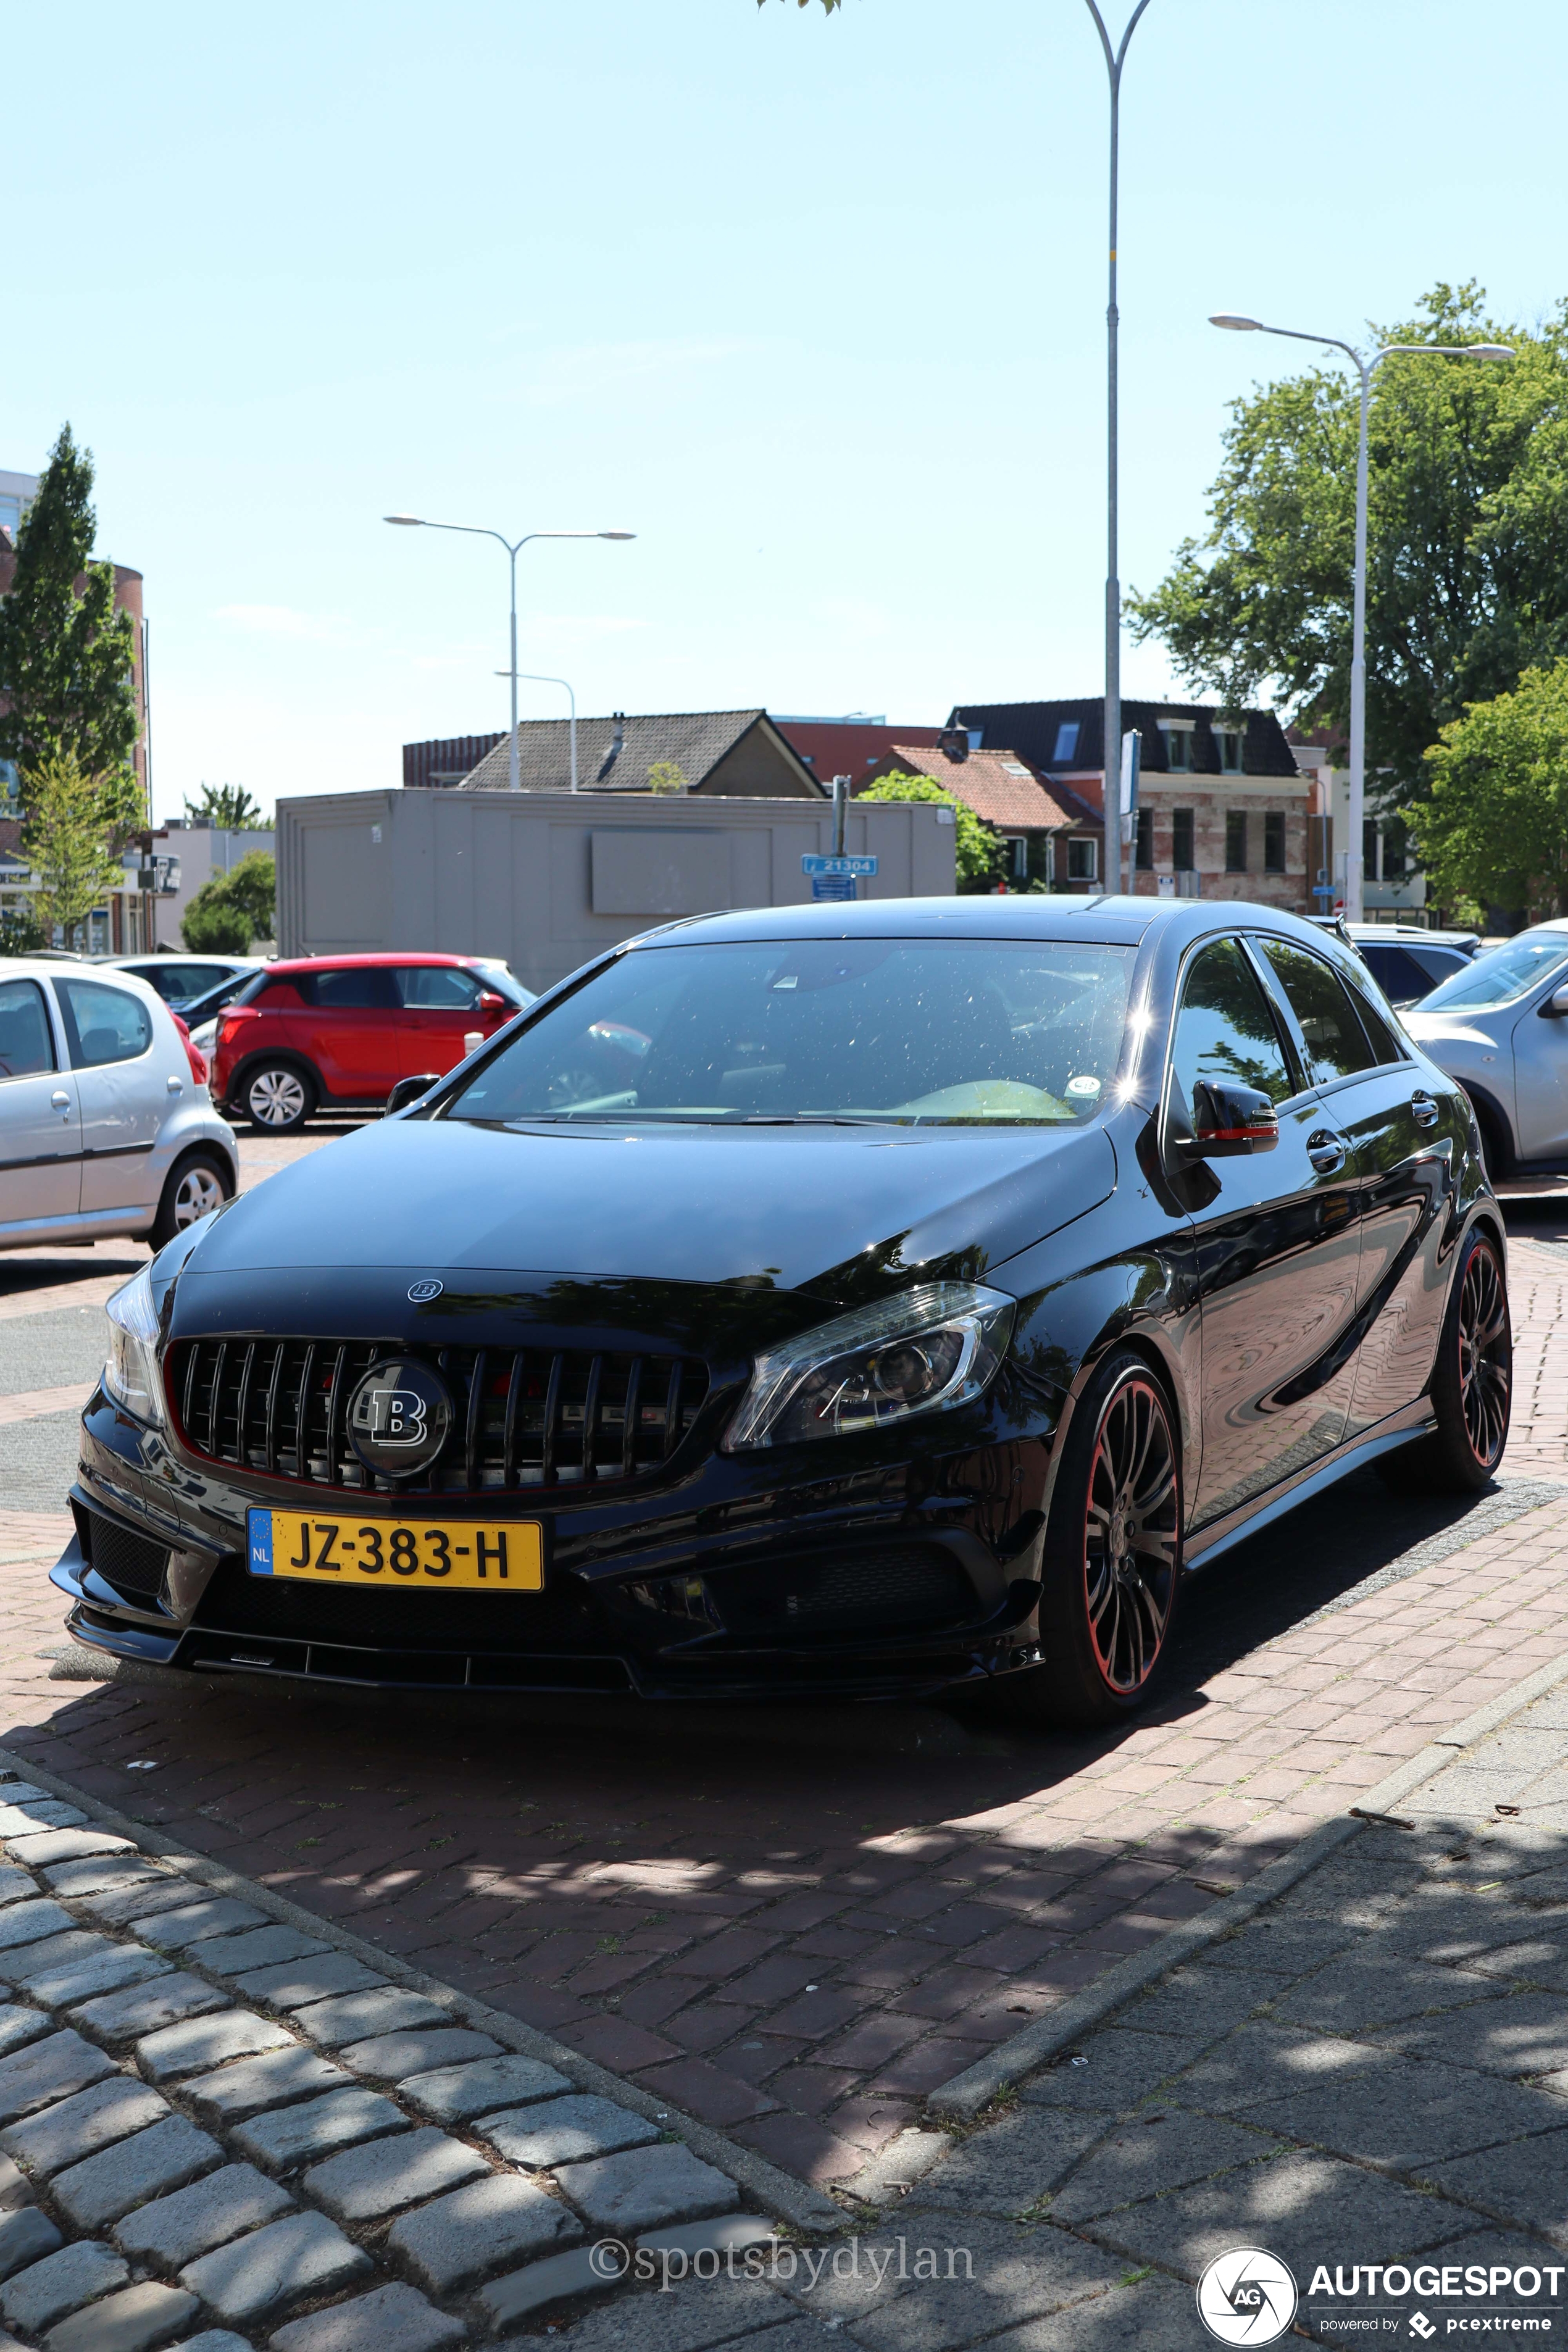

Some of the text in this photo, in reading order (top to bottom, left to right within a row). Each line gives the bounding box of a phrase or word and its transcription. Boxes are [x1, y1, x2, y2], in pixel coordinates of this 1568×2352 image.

[824, 860, 870, 871] 21304
[371, 1390, 427, 1446] B
[252, 1547, 270, 1562] NL
[290, 1522, 508, 1579] JZ-383-H
